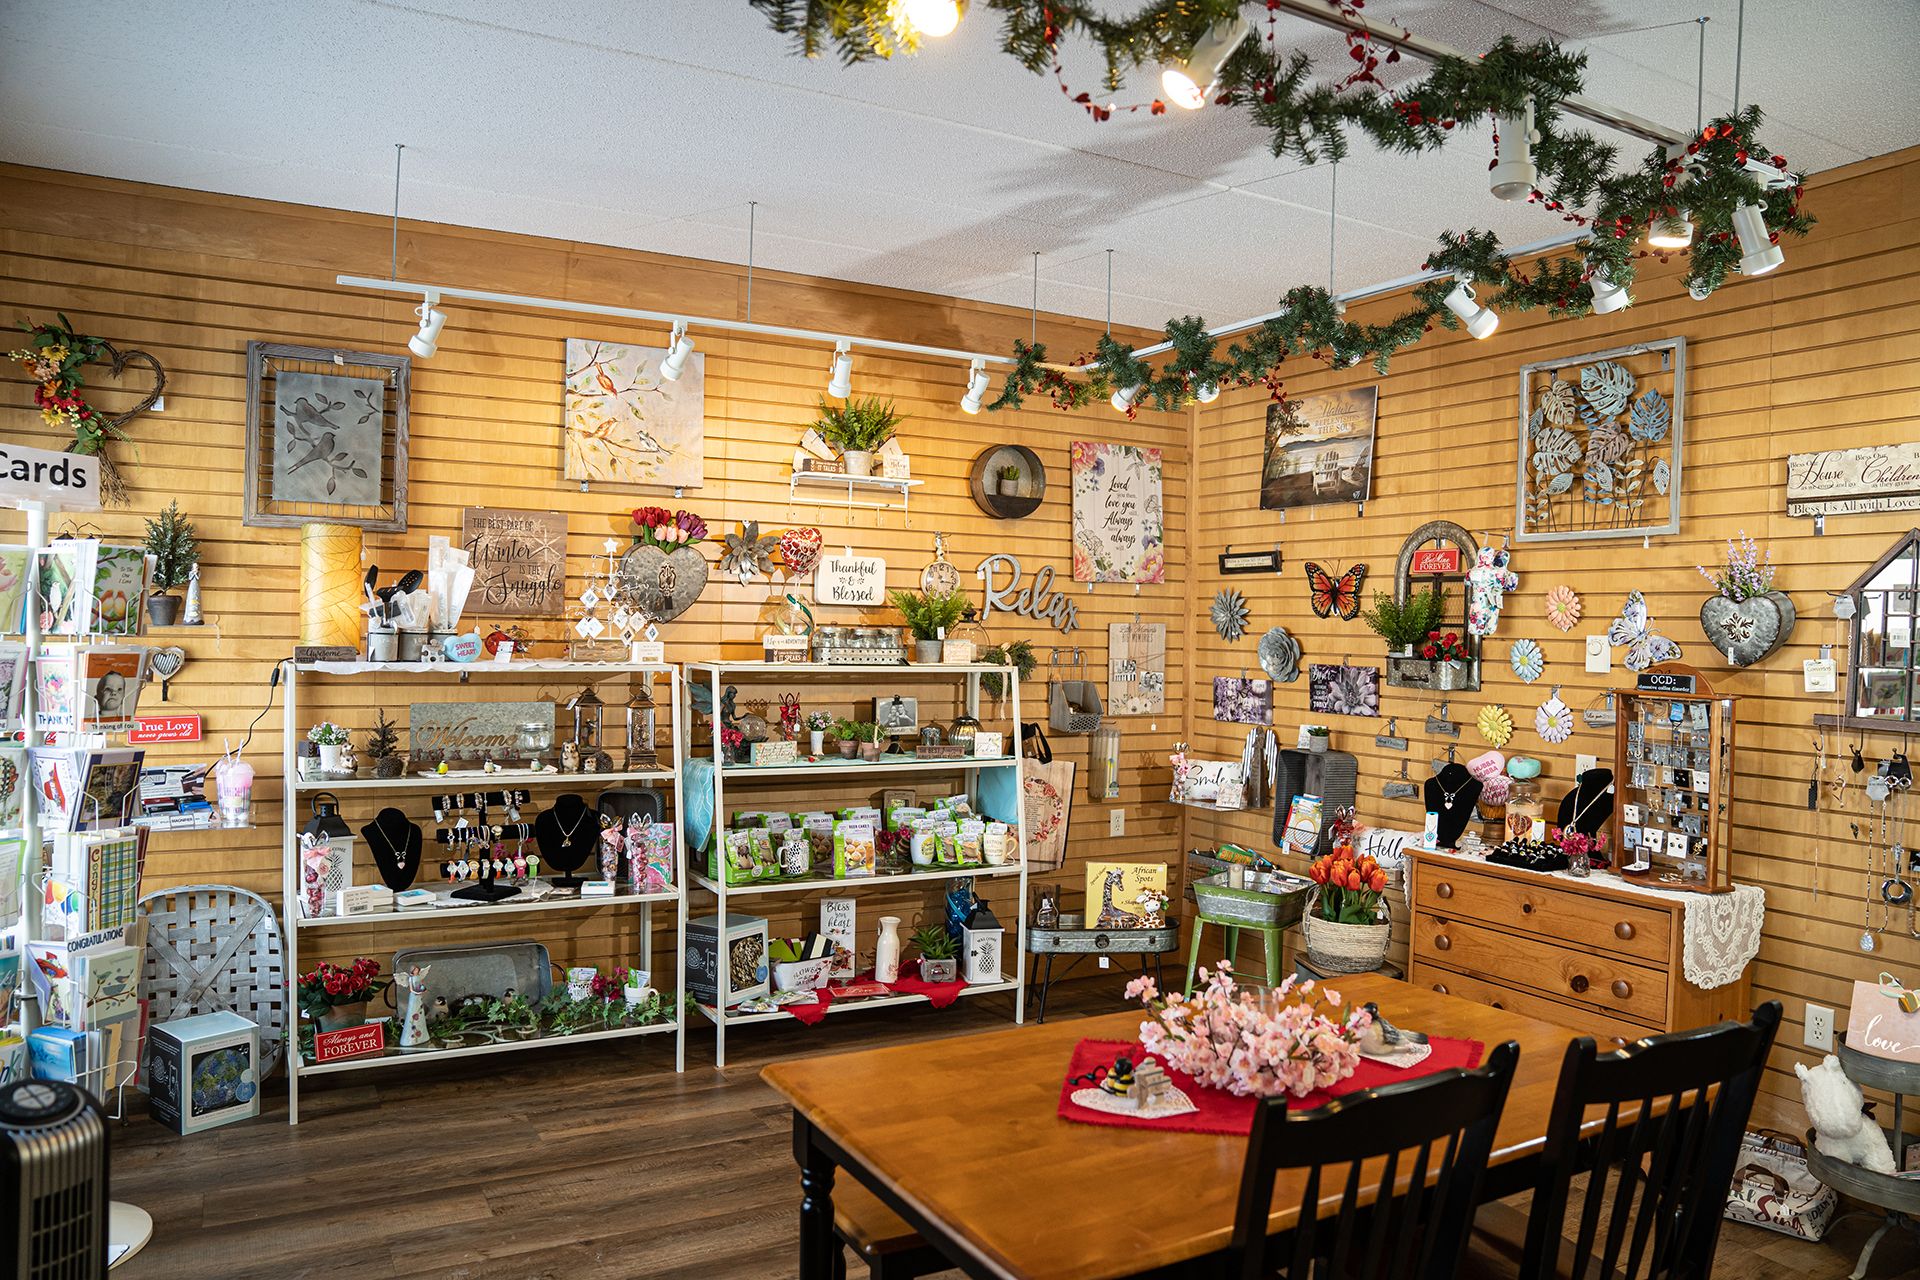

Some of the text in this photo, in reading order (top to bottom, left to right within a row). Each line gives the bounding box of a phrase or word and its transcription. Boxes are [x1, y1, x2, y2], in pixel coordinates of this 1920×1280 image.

[1789, 452, 1920, 489] House Children
[1108, 475, 1130, 492] Loved
[1105, 495, 1135, 515] love you
[1793, 498, 1915, 514] Bless Us All with Love
[472, 518, 534, 531] THE BEST PART OF
[1101, 511, 1133, 531] Always
[1110, 529, 1136, 548] always
[464, 530, 546, 569] Winter
[519, 564, 541, 575] IS THE
[830, 560, 877, 577] Thankful
[1419, 562, 1451, 570] FOREVER
[484, 564, 561, 606] Snuggle
[832, 586, 875, 601] Blessed
[976, 553, 1080, 634] Relax
[454, 641, 476, 651] SWEET
[456, 648, 477, 657] HEART
[1650, 675, 1677, 685] OCD:
[137, 720, 193, 731] True Love
[416, 716, 520, 750] Welcome
[157, 731, 177, 741] grows
[178, 729, 193, 737] old
[1472, 760, 1496, 774] HUBBA
[1186, 765, 1225, 786] Smile
[1131, 866, 1157, 875] African
[1135, 875, 1153, 884] Spots
[825, 901, 850, 912] Bless
[828, 916, 852, 928] heart
[67, 927, 124, 953] CONGRATULATIONS
[323, 1029, 376, 1046] Always and
[1864, 1014, 1908, 1053] love
[324, 1038, 378, 1057] FOREVER
